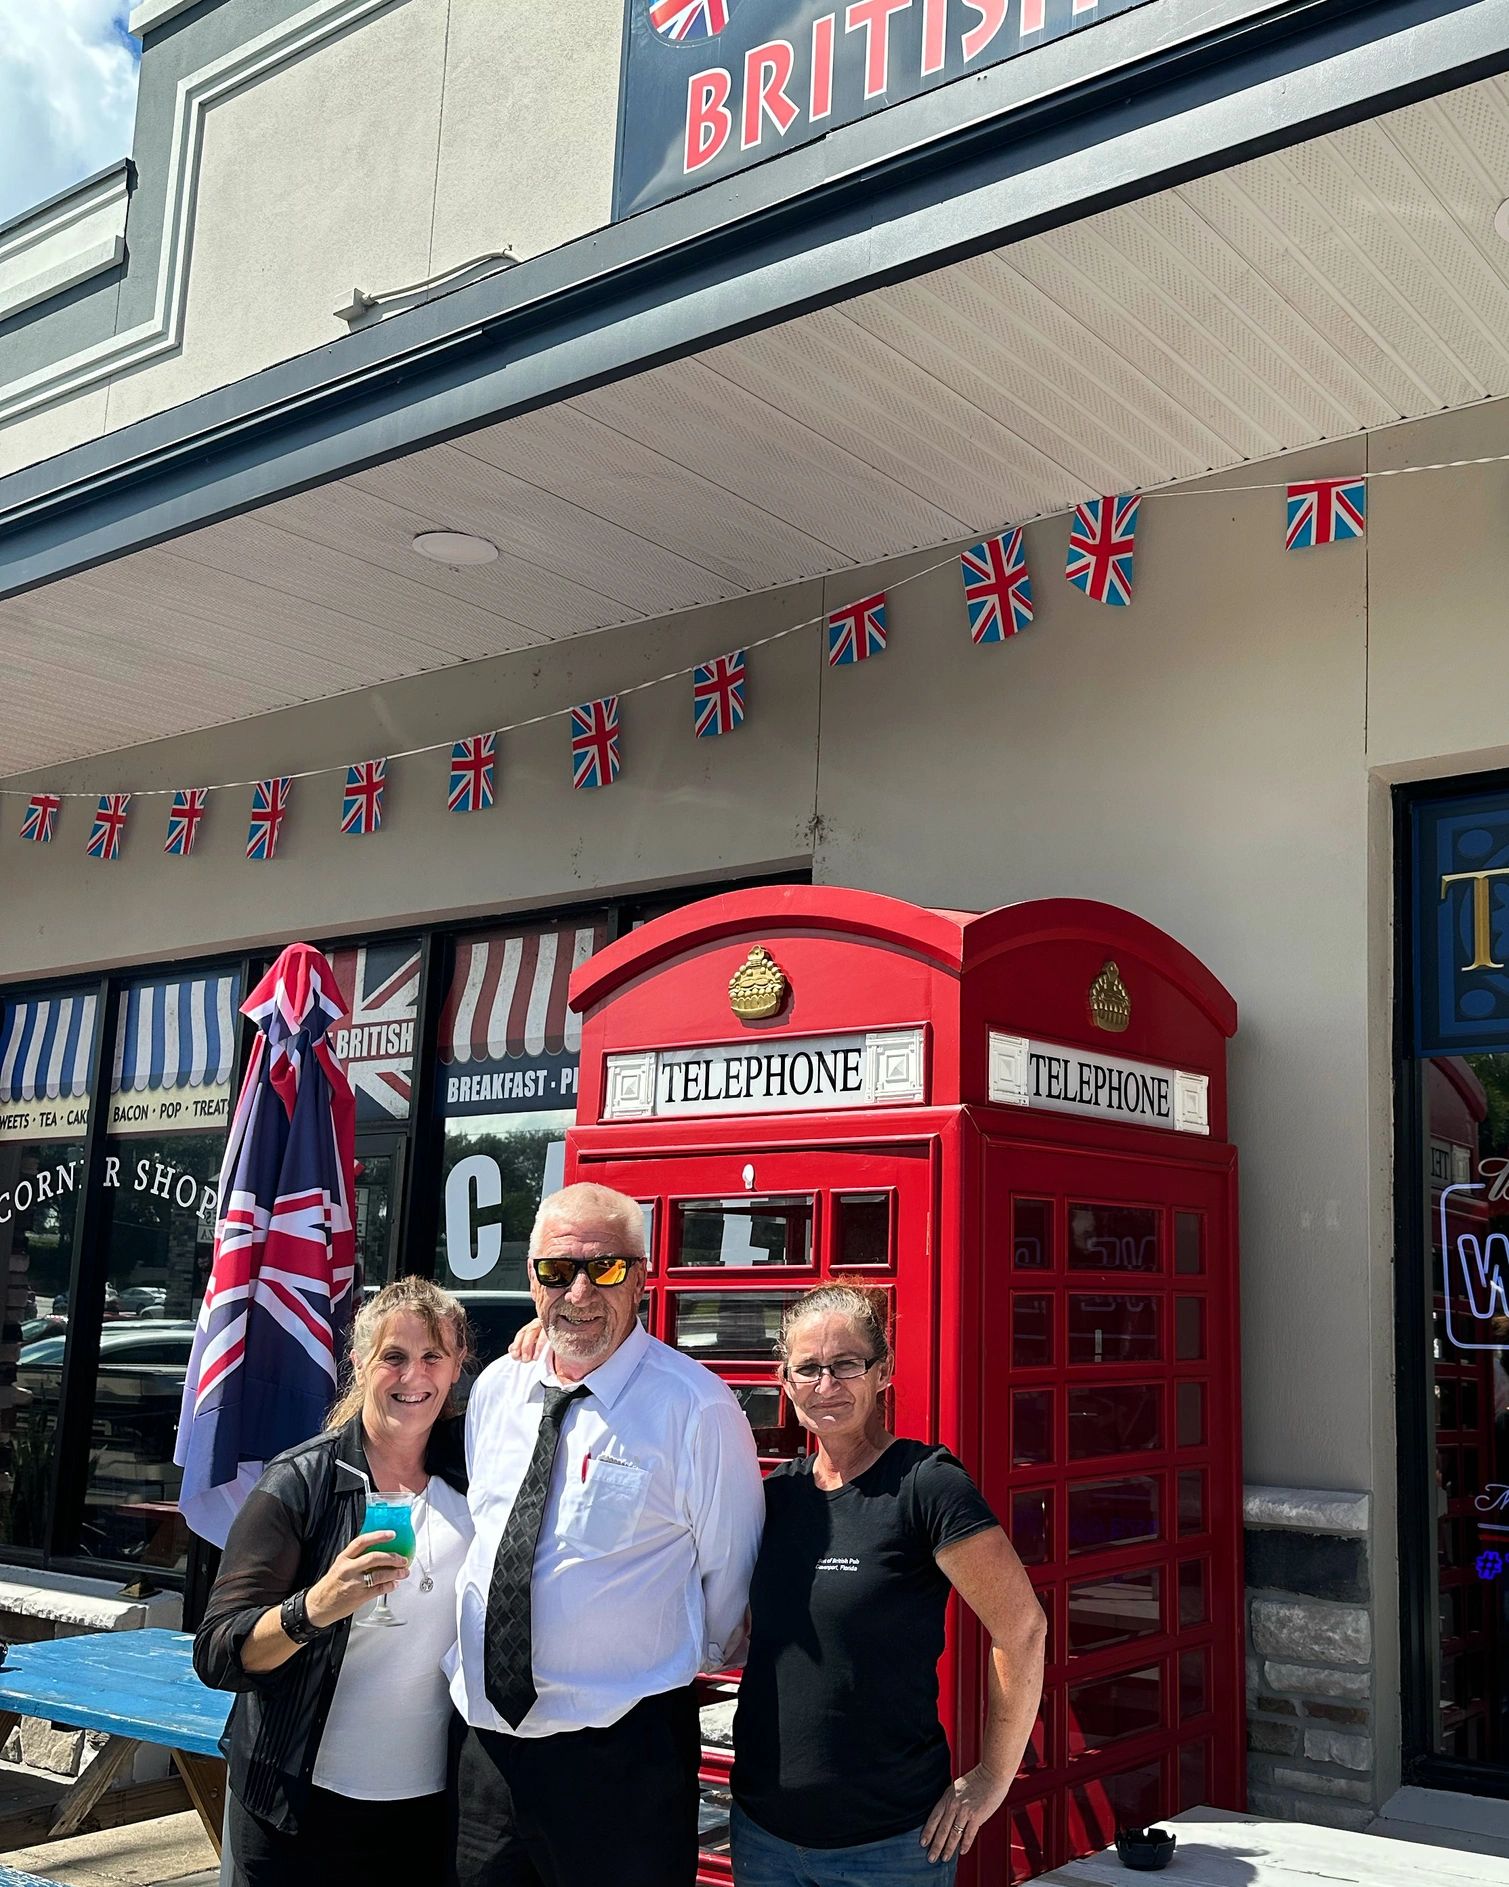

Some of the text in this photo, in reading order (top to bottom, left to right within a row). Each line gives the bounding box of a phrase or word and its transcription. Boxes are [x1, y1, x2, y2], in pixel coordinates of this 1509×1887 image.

[335, 1022, 415, 1059] BRITISH
[447, 1069, 548, 1103] BREAKFAST
[662, 1047, 863, 1104] TELEPHONE
[1029, 1053, 1170, 1118] TELEPHONE
[39, 1111, 57, 1128] TEA
[67, 1108, 90, 1126] CAK
[113, 1104, 149, 1123] BACON
[159, 1102, 182, 1119] POP
[133, 1159, 218, 1220] SHOP
